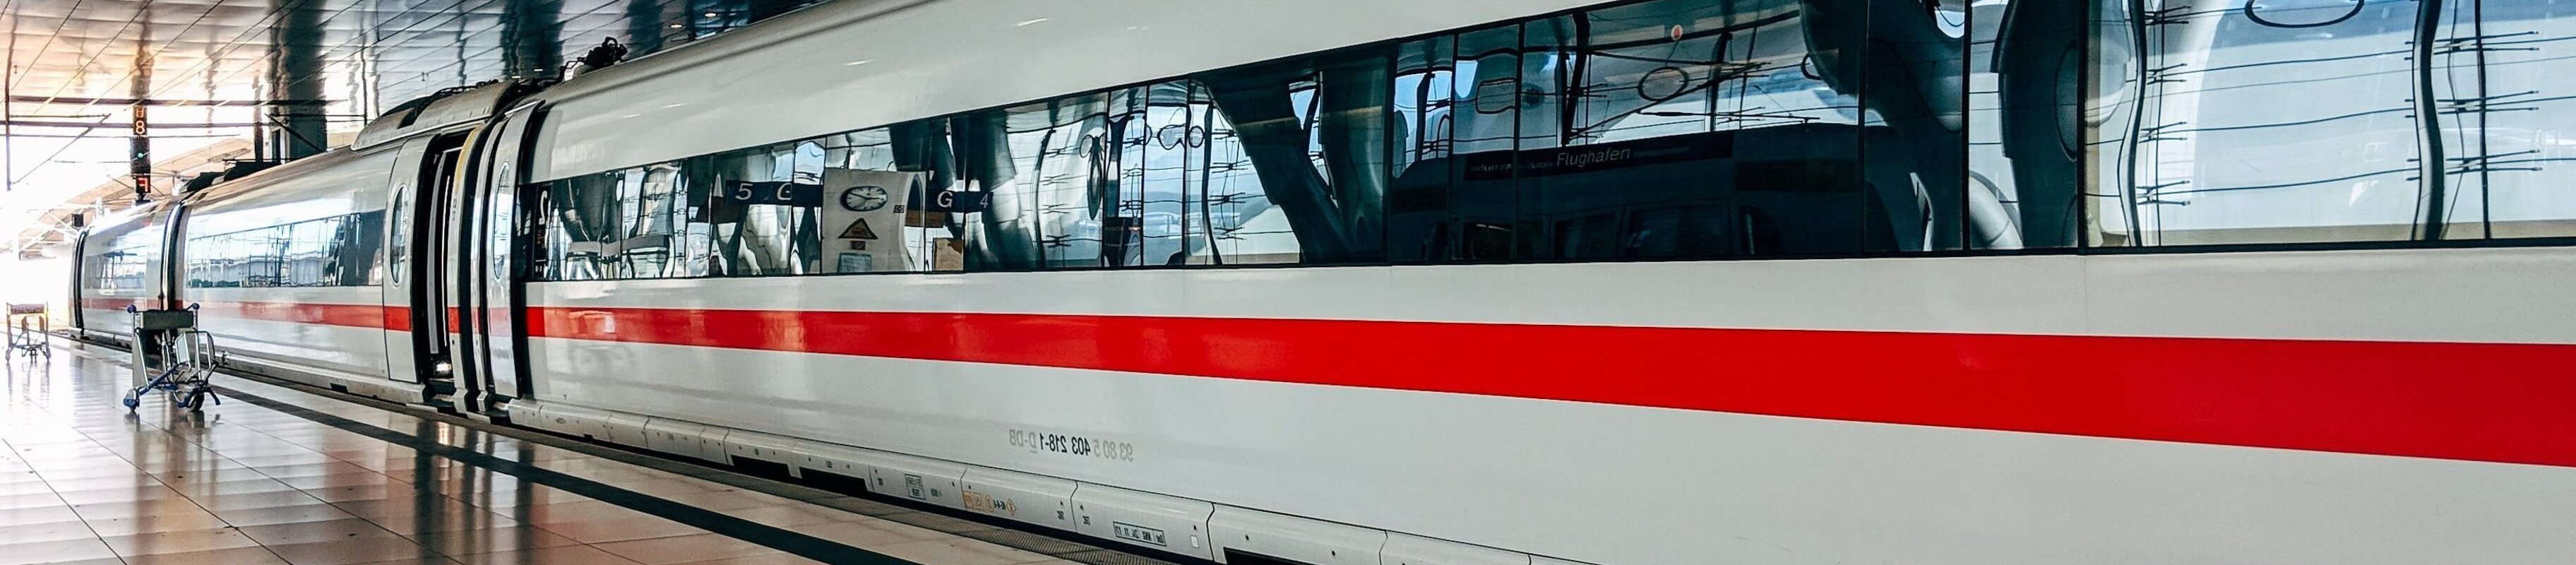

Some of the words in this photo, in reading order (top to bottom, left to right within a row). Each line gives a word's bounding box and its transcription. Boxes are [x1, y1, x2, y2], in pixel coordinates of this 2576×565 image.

[136, 120, 145, 134] 8
[1557, 148, 1630, 167] Flughafen
[735, 183, 753, 200] 5
[937, 191, 953, 208] G
[979, 193, 989, 208] 4
